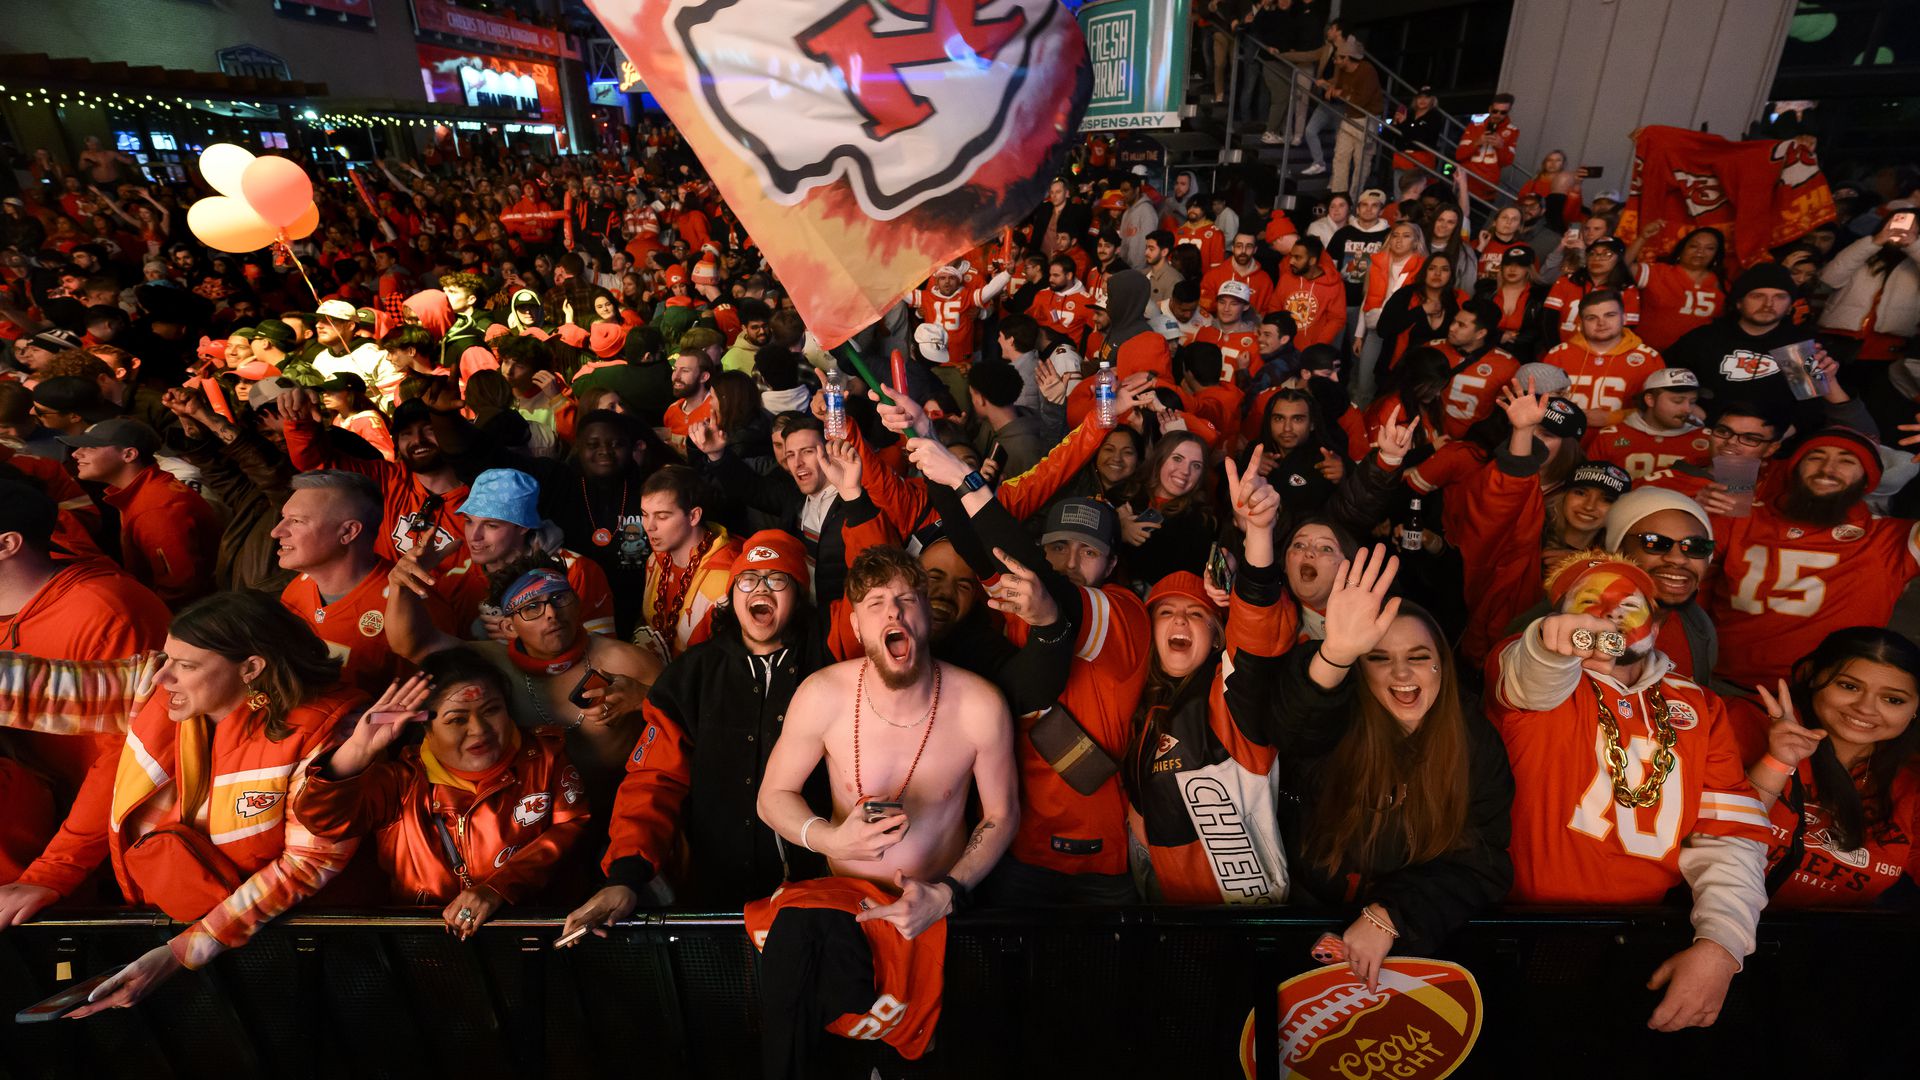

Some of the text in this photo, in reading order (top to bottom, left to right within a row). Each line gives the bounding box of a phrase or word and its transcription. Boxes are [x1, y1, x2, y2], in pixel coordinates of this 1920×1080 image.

[1090, 19, 1129, 62] FRESH
[1092, 59, 1127, 99] ARMA
[933, 300, 962, 331] 15
[1679, 290, 1716, 317] 15
[1219, 346, 1240, 383] 5
[1543, 408, 1565, 425] IONS
[1574, 470, 1624, 493] CHAMPIONS
[1731, 544, 1841, 618] 15
[1151, 757, 1183, 774] HIEFS
[1566, 725, 1684, 862] 10
[1770, 824, 1790, 841] ST.
[1329, 1023, 1431, 1080] Coors
[1374, 1043, 1445, 1080] IGHT
